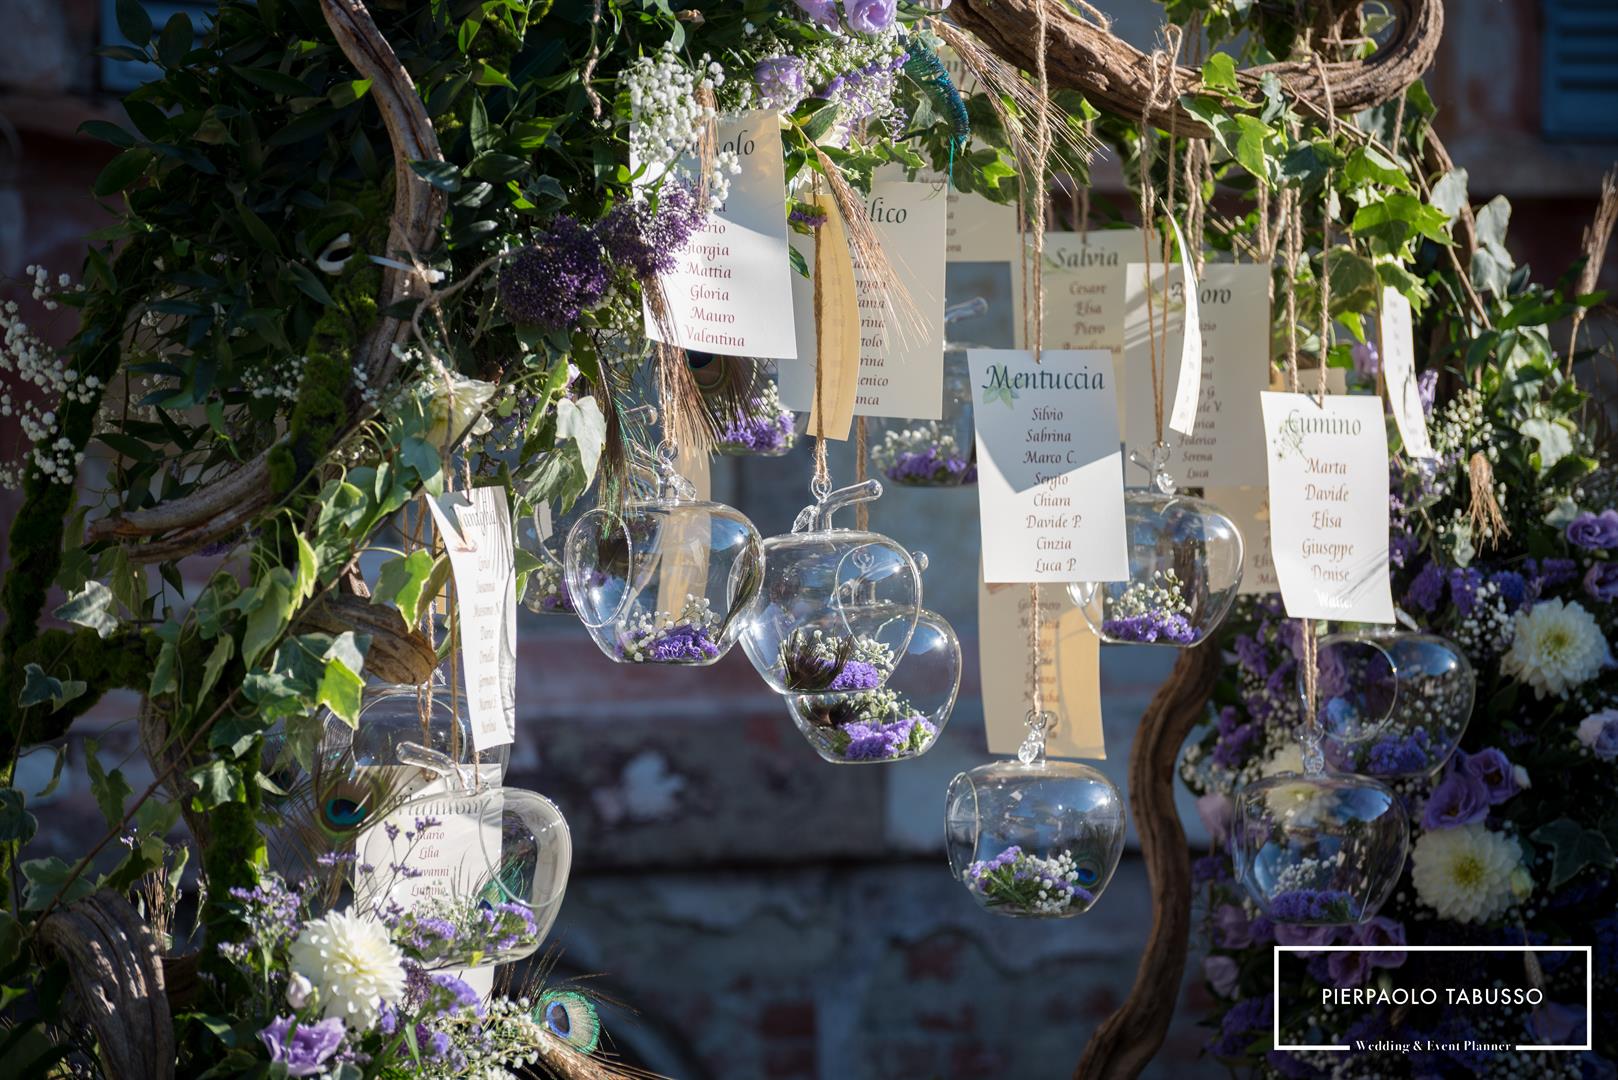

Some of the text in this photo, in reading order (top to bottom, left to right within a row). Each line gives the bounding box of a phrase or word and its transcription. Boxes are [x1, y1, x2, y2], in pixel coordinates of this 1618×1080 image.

[1056, 246, 1119, 268] Salvia
[686, 261, 732, 279] Mattia
[690, 283, 729, 301] Gloria
[690, 306, 735, 324] Mauro
[685, 324, 745, 347] Valentina
[982, 364, 1106, 390] Mentuccia
[1031, 405, 1064, 421] Silvio
[1288, 408, 1361, 436] Cumino
[1025, 427, 1072, 443] Sabrina
[1022, 450, 1061, 464] Marco
[1305, 457, 1347, 475] Marta
[1034, 472, 1069, 490] Sergio
[1033, 493, 1071, 507] Chiara
[1305, 482, 1349, 501] Davide
[1026, 513, 1068, 529] Davide
[1311, 508, 1342, 530] Elisa
[1036, 536, 1072, 550] Cinzia
[1302, 538, 1354, 562] Giuseppe
[1035, 558, 1062, 574] Luca
[1311, 564, 1350, 582] Denise
